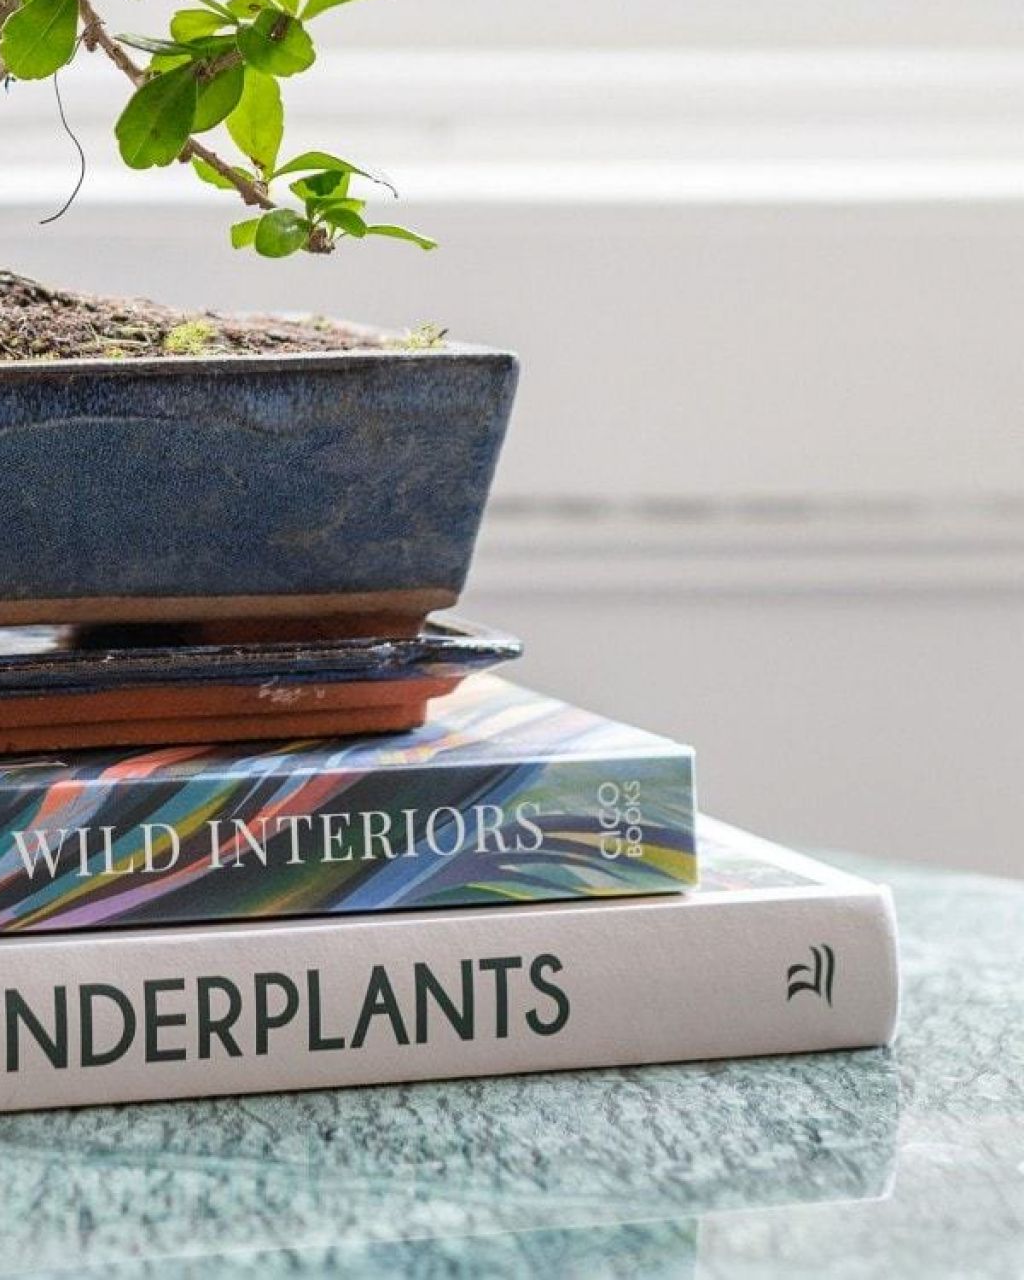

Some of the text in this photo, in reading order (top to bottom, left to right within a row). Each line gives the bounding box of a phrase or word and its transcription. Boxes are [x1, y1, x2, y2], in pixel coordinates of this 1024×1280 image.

[12, 823, 182, 880] WILD
[208, 801, 545, 868] INTERIORS
[598, 782, 621, 859] CICO
[625, 780, 643, 857] BOOKS
